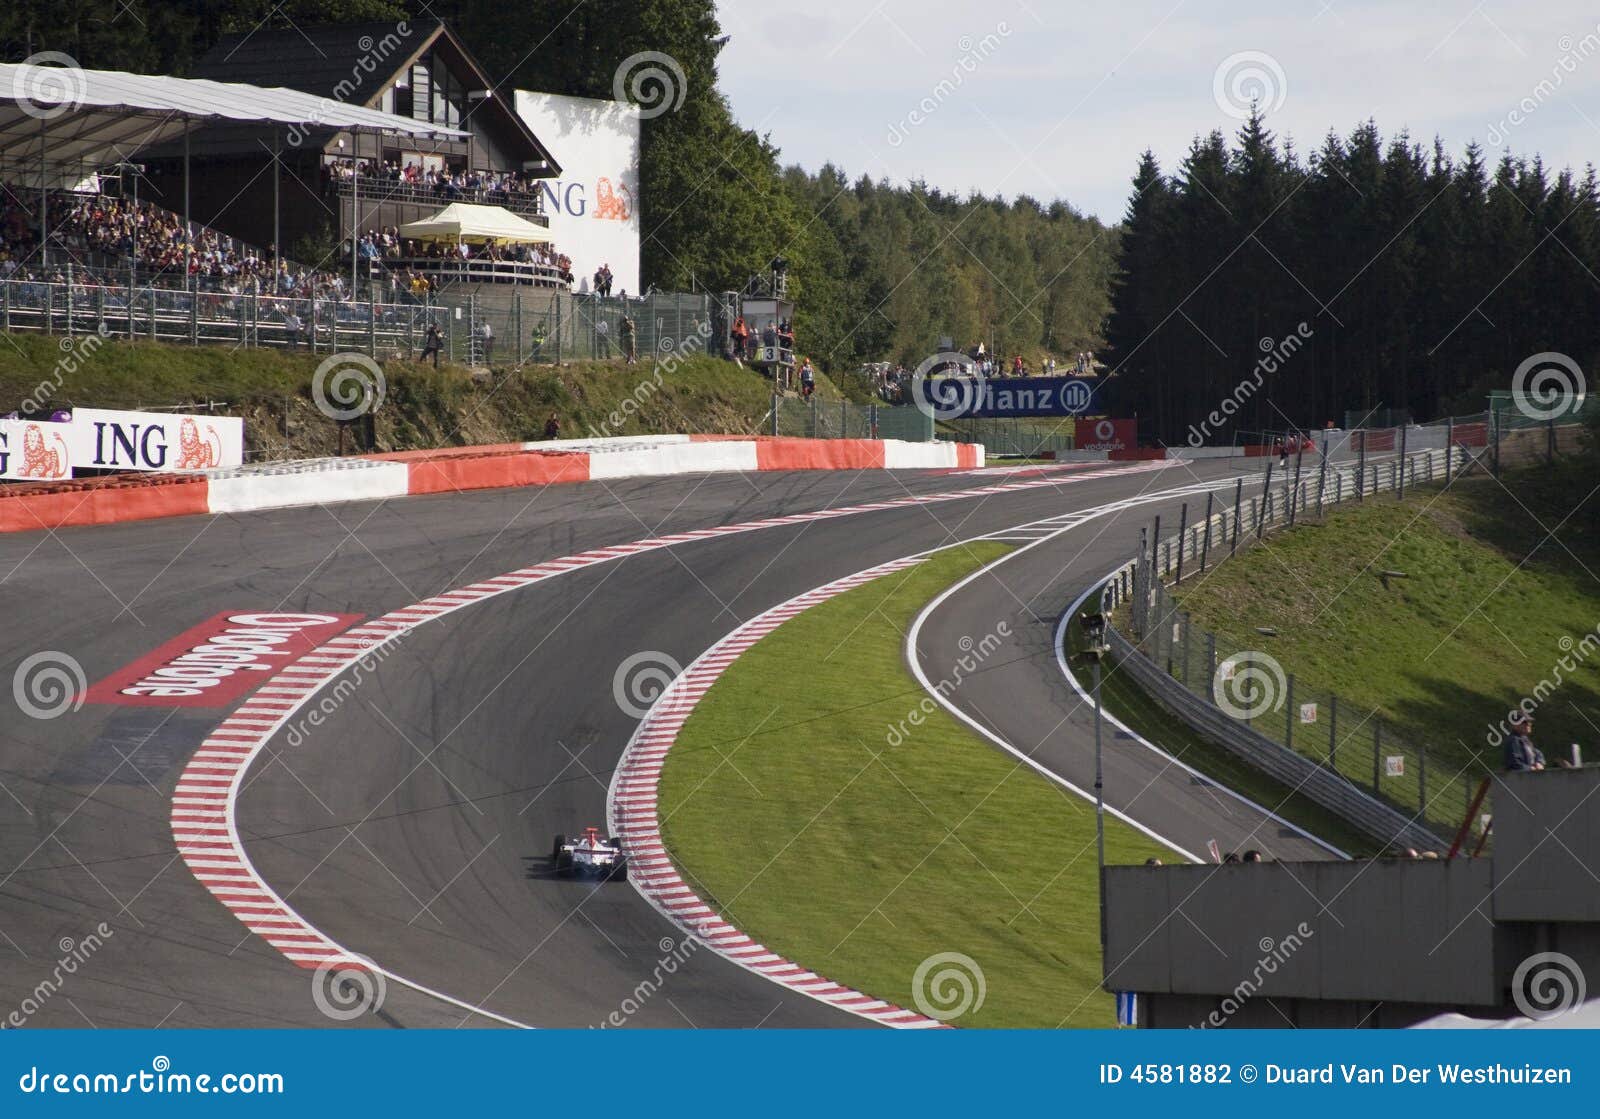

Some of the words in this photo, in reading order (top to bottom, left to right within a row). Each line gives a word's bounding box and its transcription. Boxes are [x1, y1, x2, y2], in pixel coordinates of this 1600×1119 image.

[539, 180, 586, 217] NG
[766, 348, 774, 360] 3
[92, 421, 168, 469] ING
[121, 627, 302, 696] vodafone
